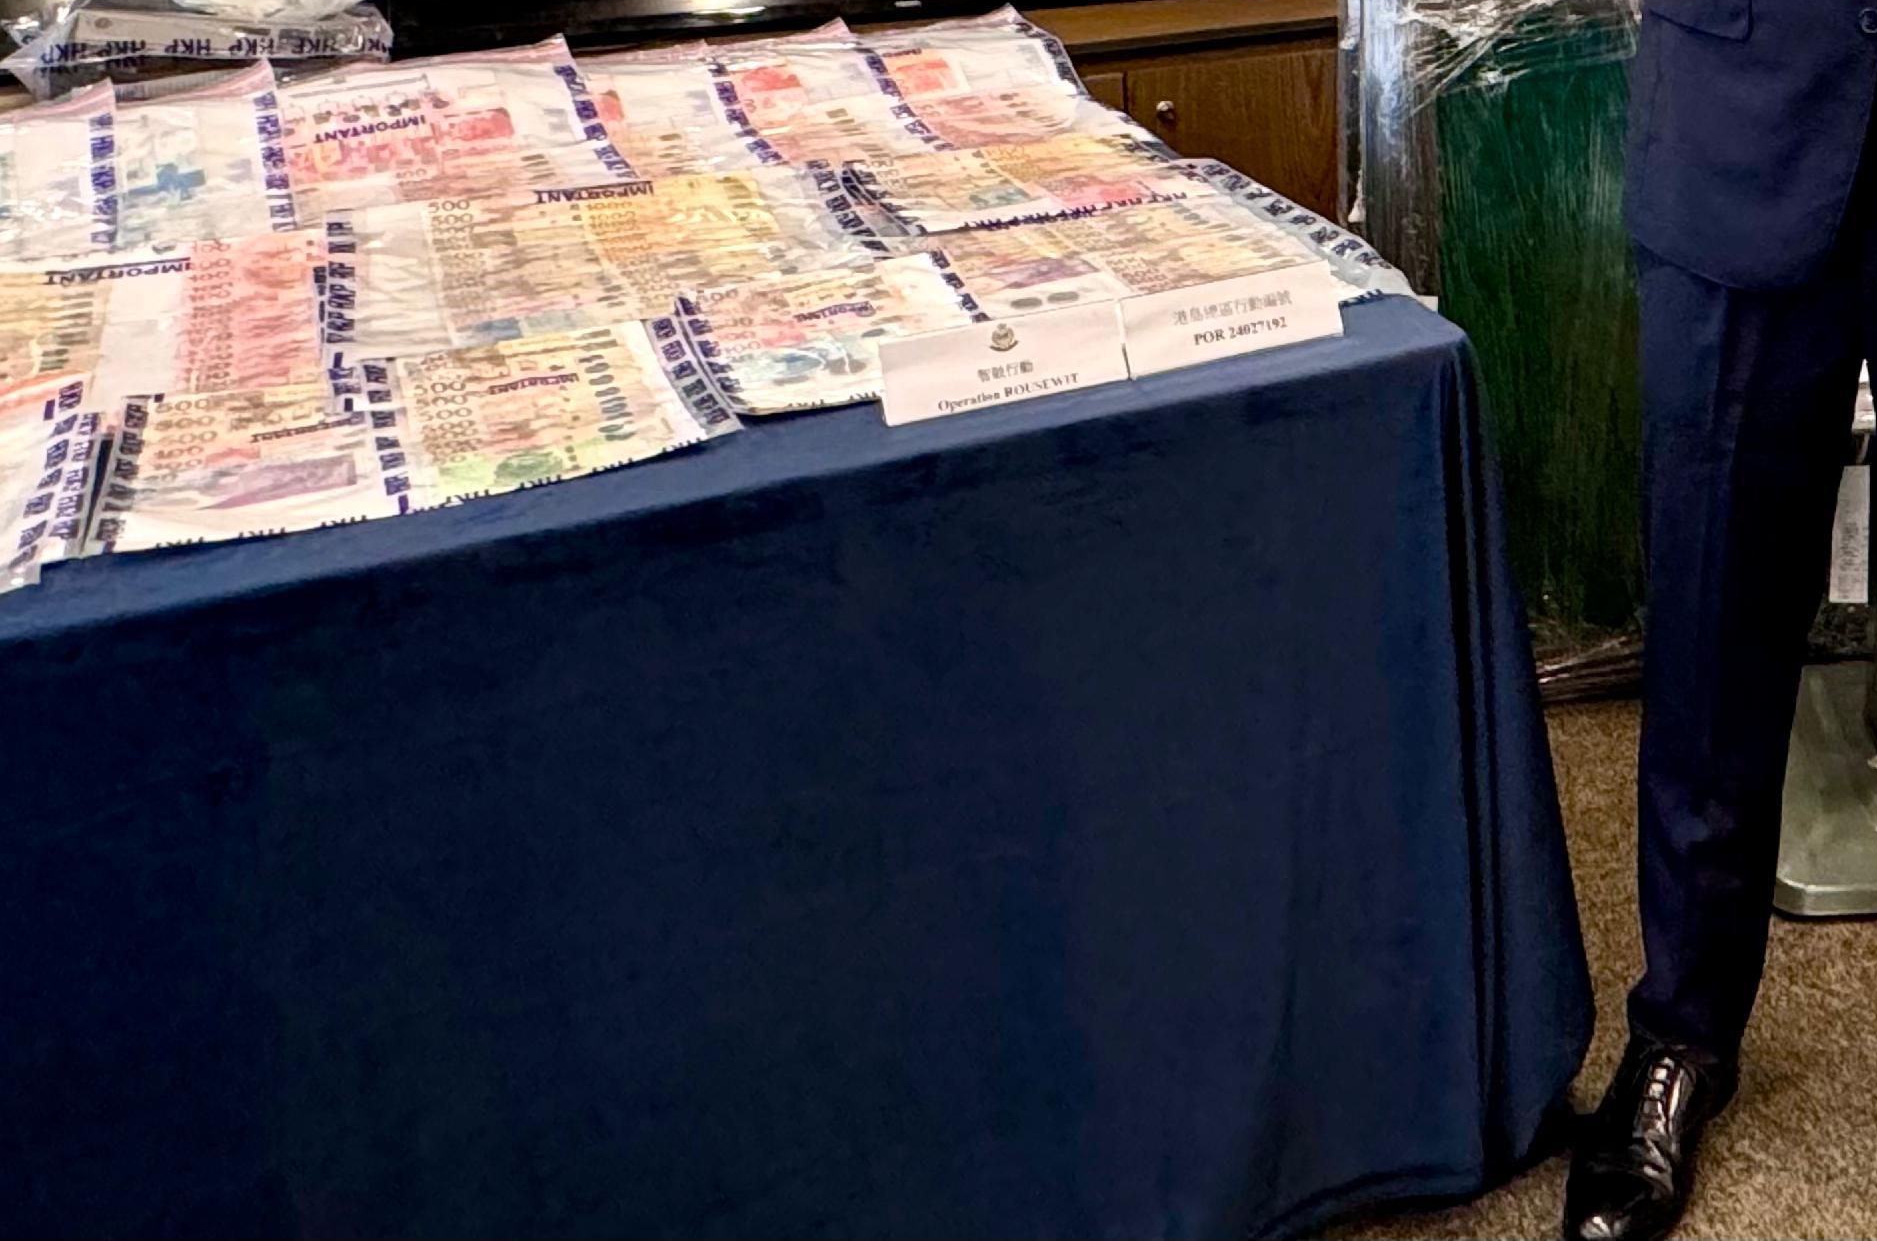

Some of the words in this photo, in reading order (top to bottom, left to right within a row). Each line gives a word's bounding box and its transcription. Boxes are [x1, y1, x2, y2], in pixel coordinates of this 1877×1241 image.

[164, 38, 211, 55] HKP
[313, 114, 426, 143] IMPORTANT
[537, 183, 654, 204] IMPORTANT
[45, 262, 191, 286] IMPORTANT
[1193, 328, 1226, 346] POR
[938, 391, 1000, 413] Operation
[1004, 372, 1080, 398] ROUSEWIT
